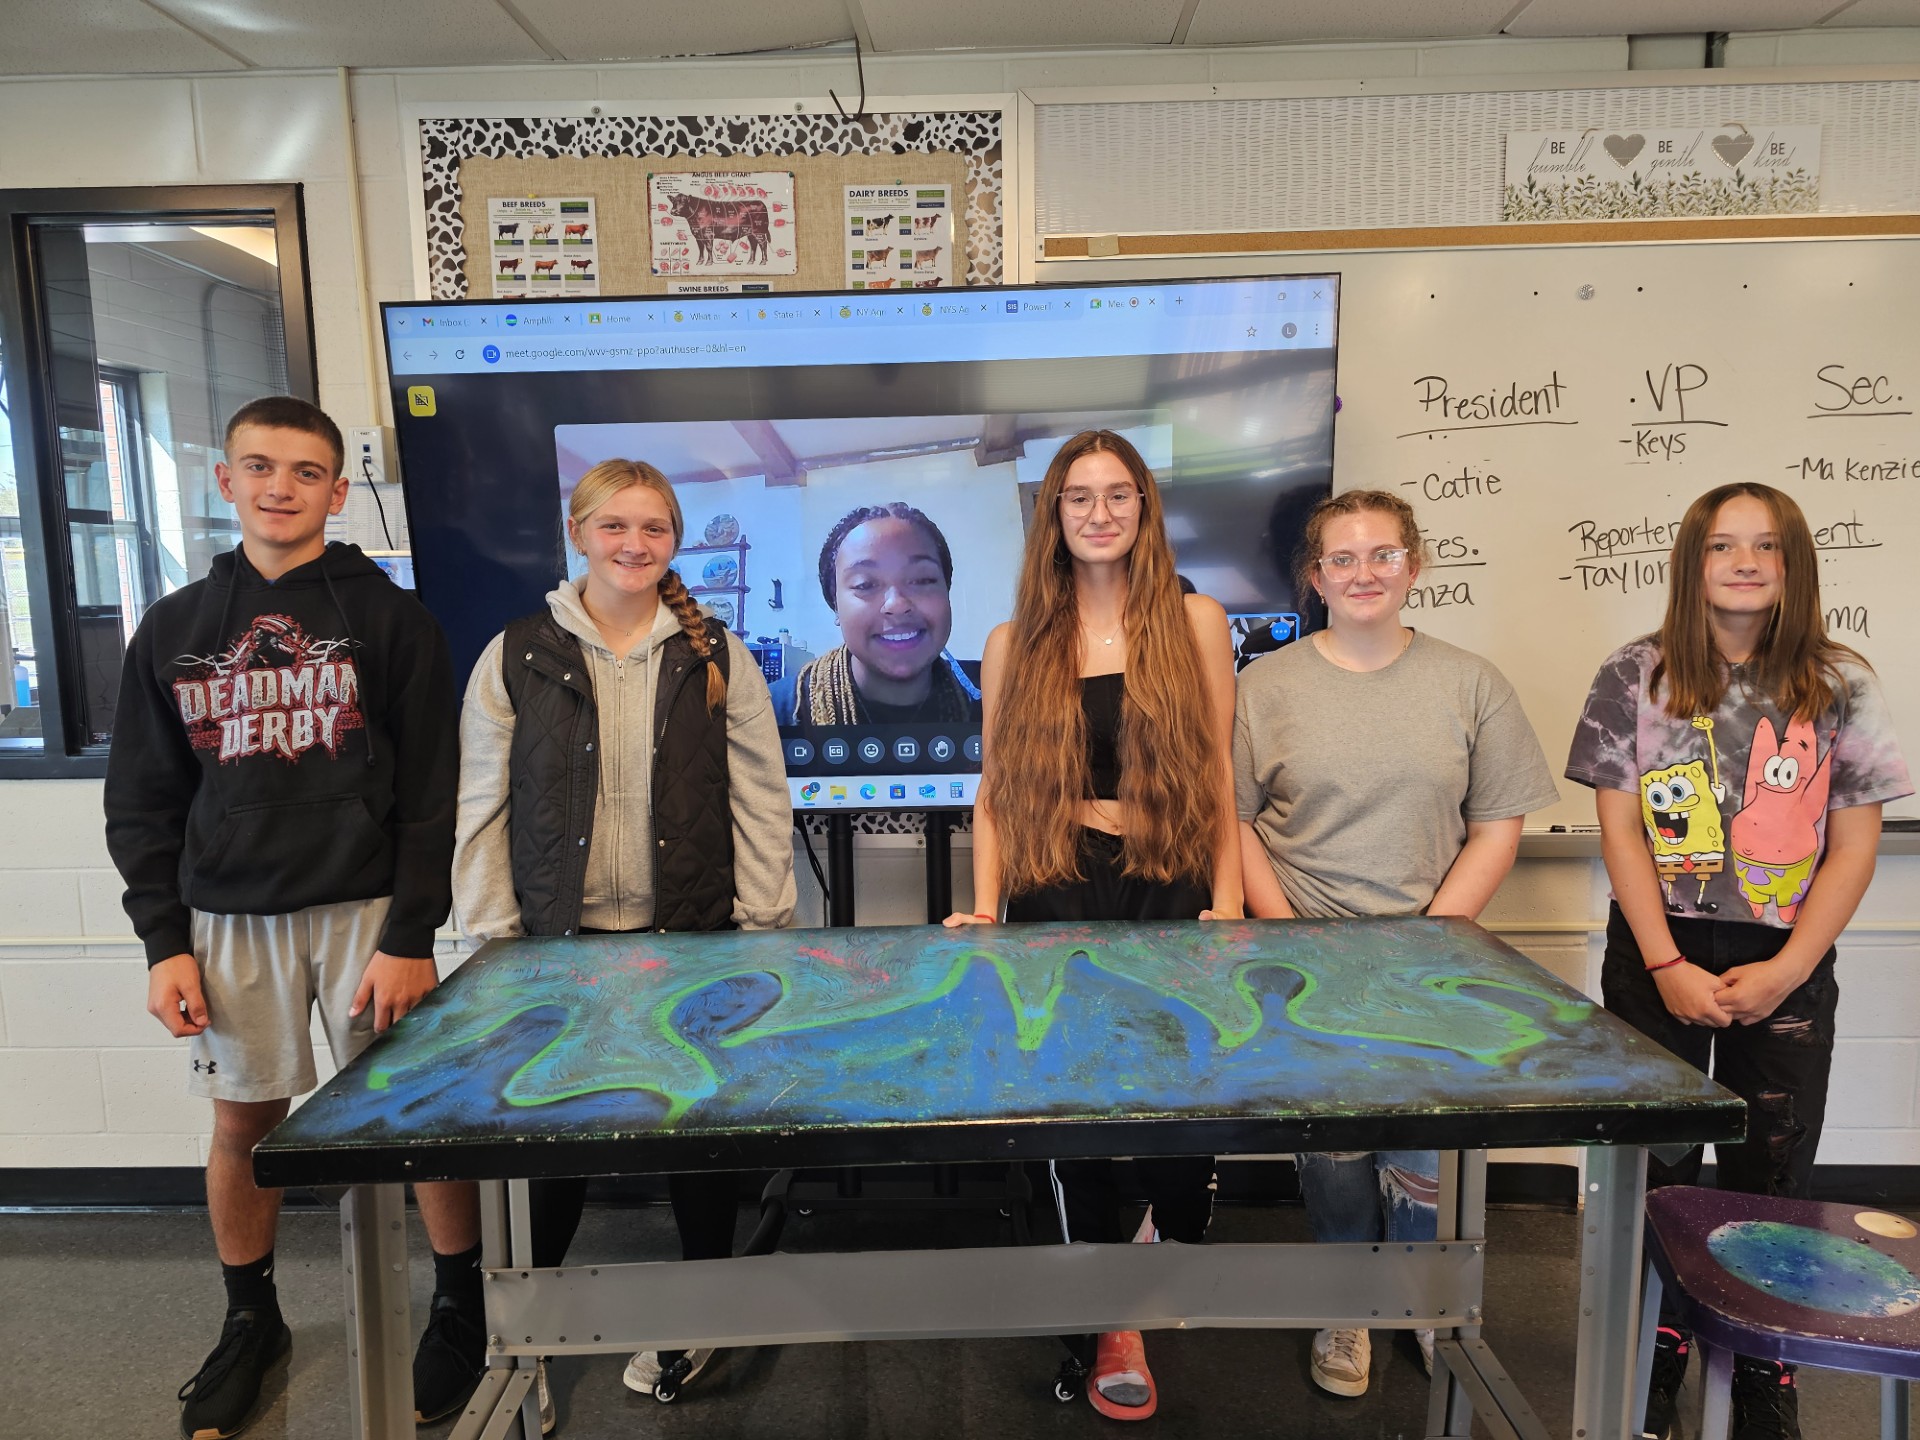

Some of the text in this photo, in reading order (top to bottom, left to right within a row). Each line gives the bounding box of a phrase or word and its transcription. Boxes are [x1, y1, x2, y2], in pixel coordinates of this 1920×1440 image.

[1527, 137, 1594, 173] humble
[1550, 141, 1566, 154] BE
[1646, 131, 1704, 179] gentle
[1658, 140, 1673, 153] BE
[1753, 131, 1797, 167] kind
[1770, 142, 1785, 155] BE
[849, 189, 909, 198] DAIRY BREEDS
[703, 285, 729, 293] BREEDS
[440, 318, 463, 327] Inbox
[606, 315, 632, 324] Home
[690, 312, 711, 321] What
[773, 309, 794, 319] State
[856, 308, 869, 317] NY
[940, 306, 957, 314] NYS
[1414, 370, 1567, 420] President
[1645, 362, 1709, 422] VP
[1814, 364, 1903, 411] Sec.
[1568, 516, 1682, 559] Reporter
[1813, 509, 1876, 546] ent.
[1419, 529, 1480, 559] res.
[1399, 582, 1475, 611] enza
[173, 662, 359, 726] DEADMAN
[217, 704, 342, 760] DERBY
